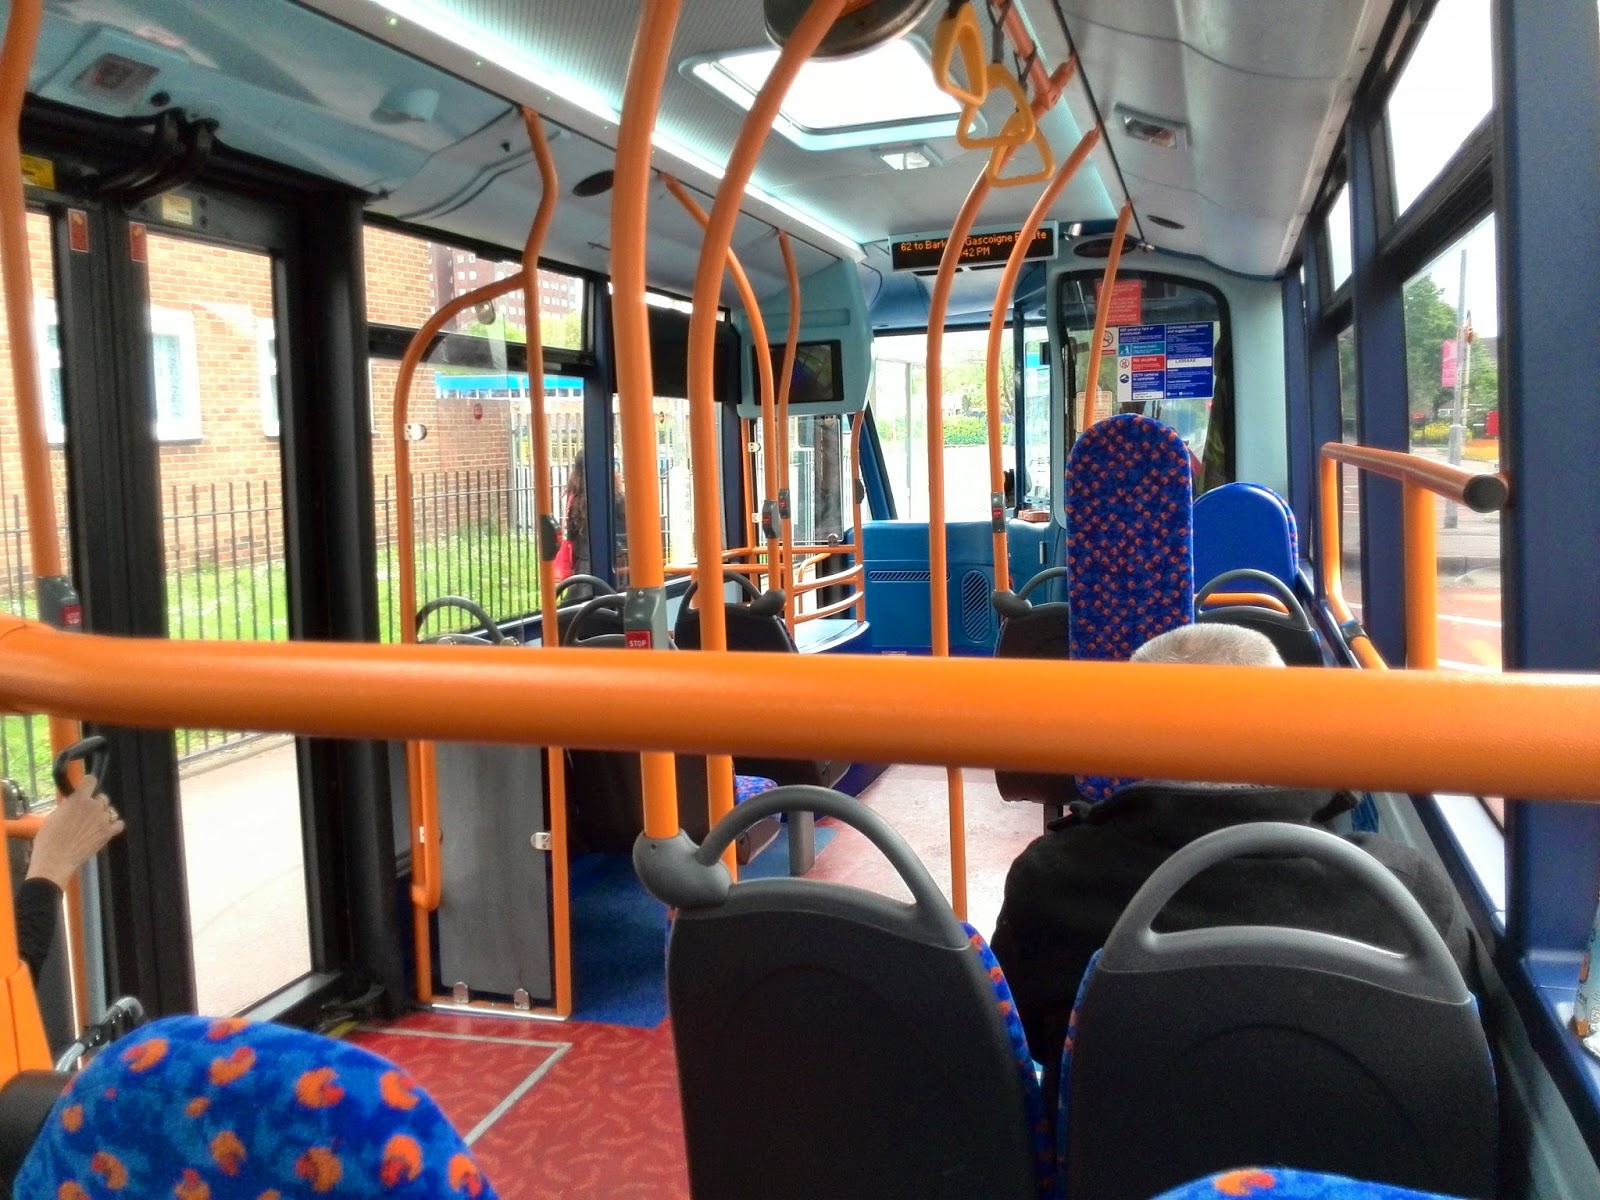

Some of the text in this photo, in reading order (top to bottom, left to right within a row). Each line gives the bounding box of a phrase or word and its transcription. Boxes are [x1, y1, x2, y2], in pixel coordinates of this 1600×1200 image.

[900, 230, 1047, 252] 62 to Bark Gascoigne Eate
[976, 246, 991, 256] PM
